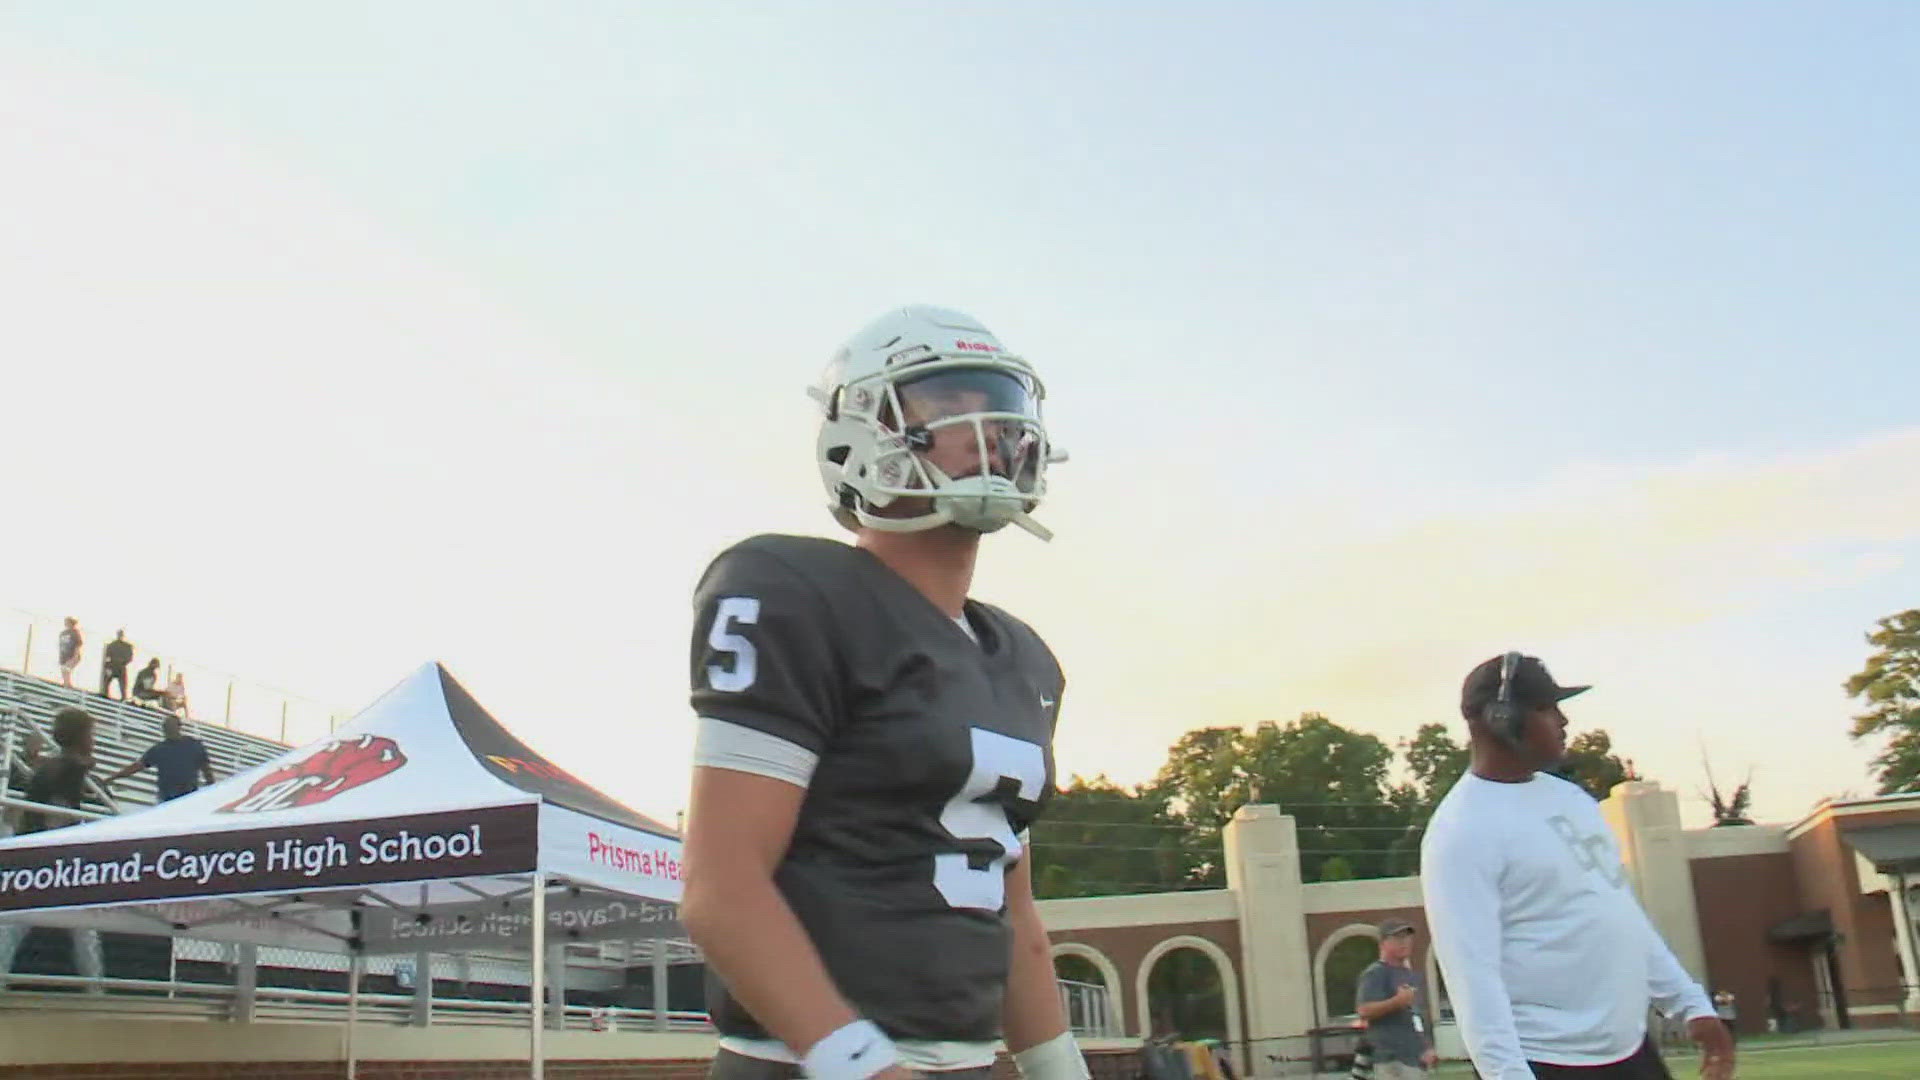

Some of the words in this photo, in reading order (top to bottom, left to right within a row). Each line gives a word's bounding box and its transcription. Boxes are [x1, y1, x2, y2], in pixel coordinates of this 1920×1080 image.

[708, 597, 761, 692] 5
[0, 849, 255, 893] rookland-Cayce
[266, 836, 347, 876] High
[359, 824, 482, 865] School
[588, 832, 652, 875] Prisma
[655, 849, 685, 881] Hea
[933, 726, 1046, 911] 5
